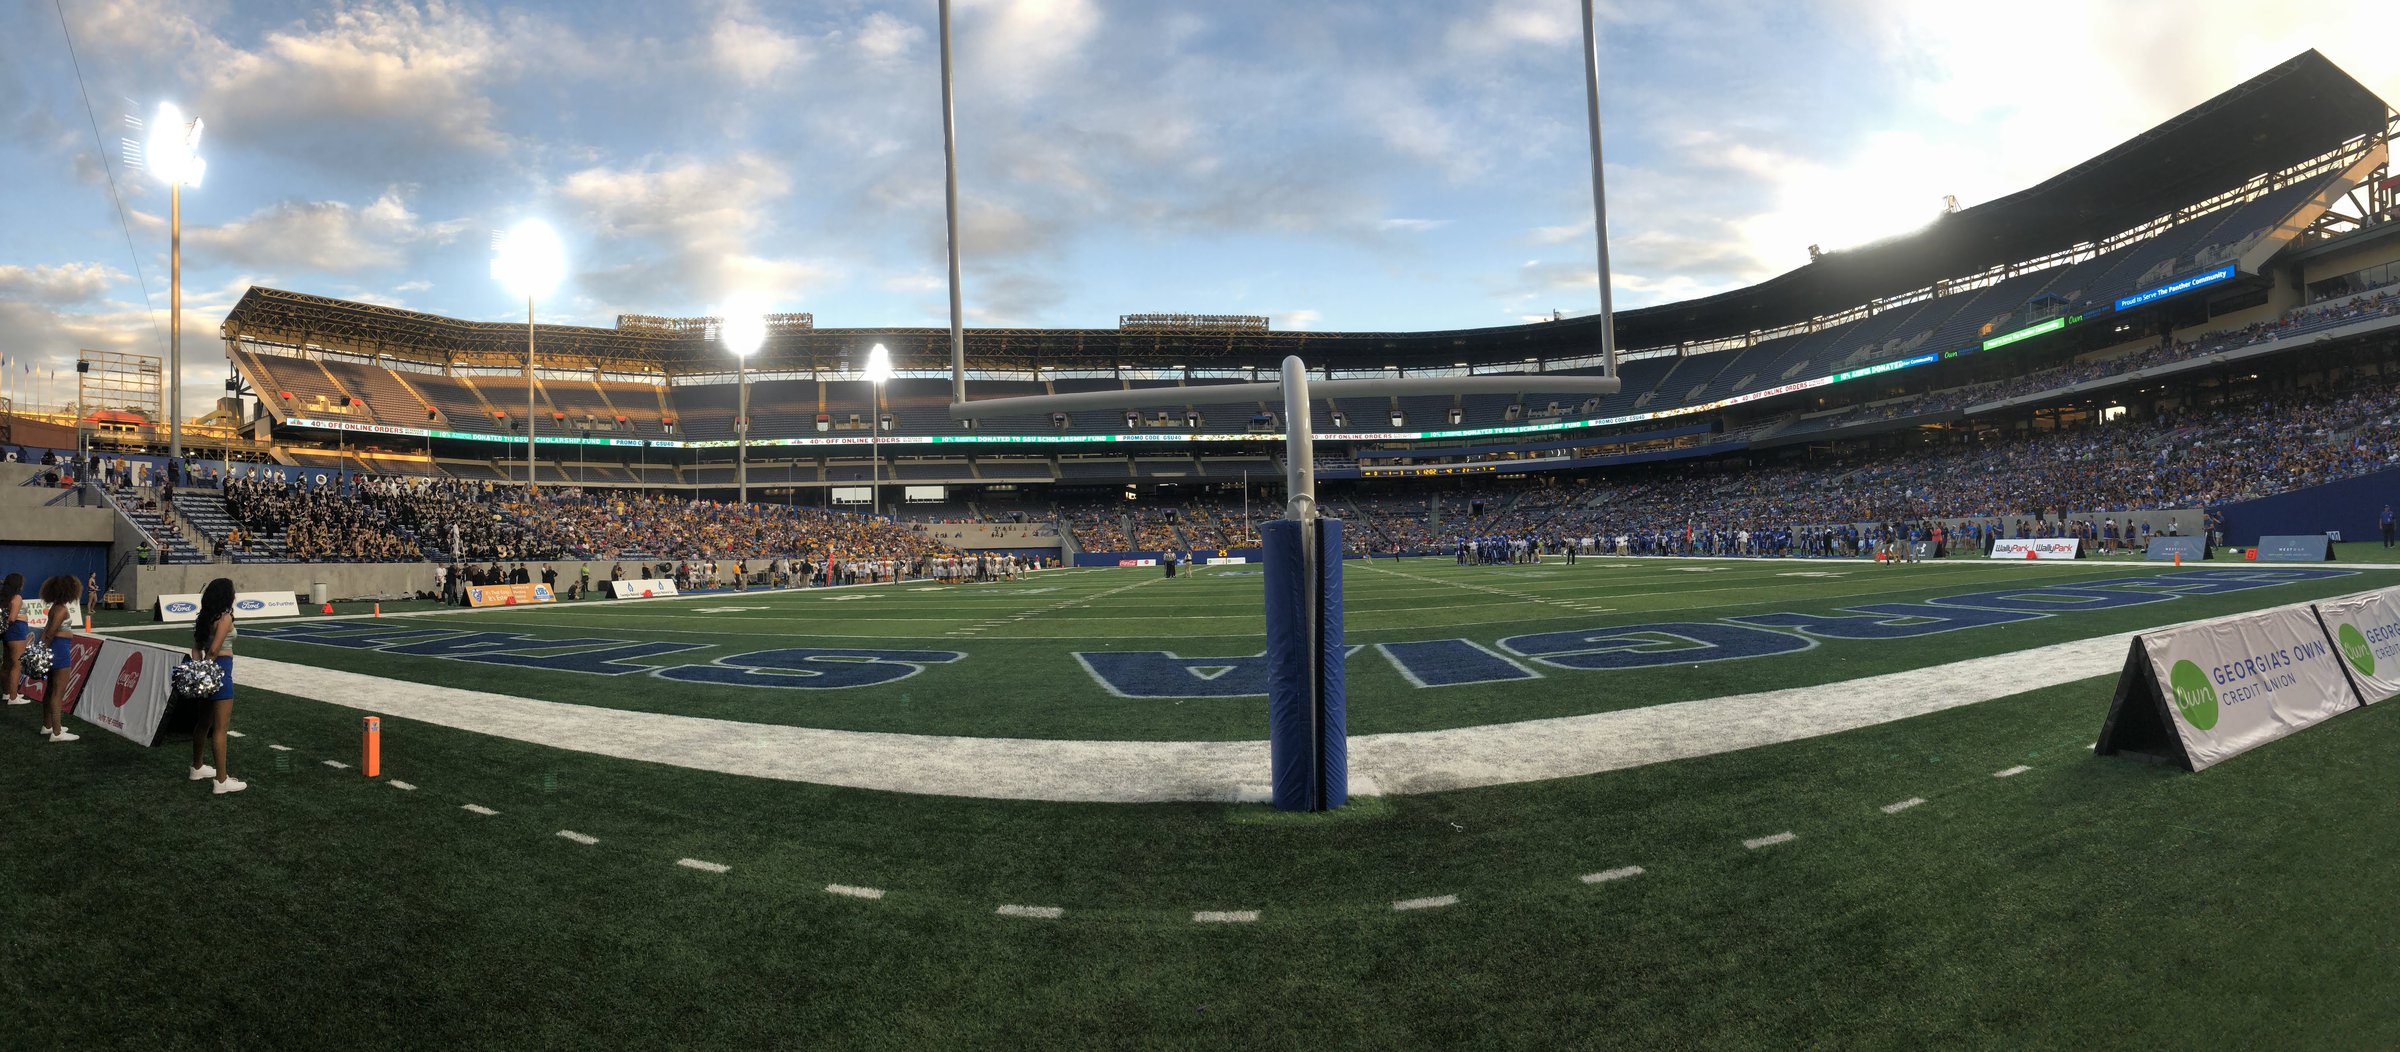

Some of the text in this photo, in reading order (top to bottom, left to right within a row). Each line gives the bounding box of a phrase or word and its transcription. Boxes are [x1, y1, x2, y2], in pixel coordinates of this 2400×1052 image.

[2121, 297, 2136, 307] Proud
[2142, 292, 2156, 300] Serve
[2157, 288, 2168, 296] The
[2168, 281, 2191, 294] Panther
[2192, 270, 2227, 286] Community
[1872, 361, 1903, 374] DONATED
[1752, 392, 1762, 400] OFF
[1764, 387, 1784, 397] ONLINE
[1785, 382, 1808, 392] ORDERS
[344, 422, 373, 432] ONLINE
[374, 426, 404, 434] ORDERS
[1462, 428, 1492, 436] DONATED
[472, 434, 503, 442] DONATED
[1995, 544, 2029, 554] WallyPark
[2036, 544, 2073, 554] WallyPark
[171, 604, 192, 612] Ford
[242, 601, 260, 610] Ford
[2213, 640, 2326, 686] GEORGIA'S OWN
[2222, 673, 2296, 706] CREDIT UNION
[2176, 686, 2214, 710] Own
